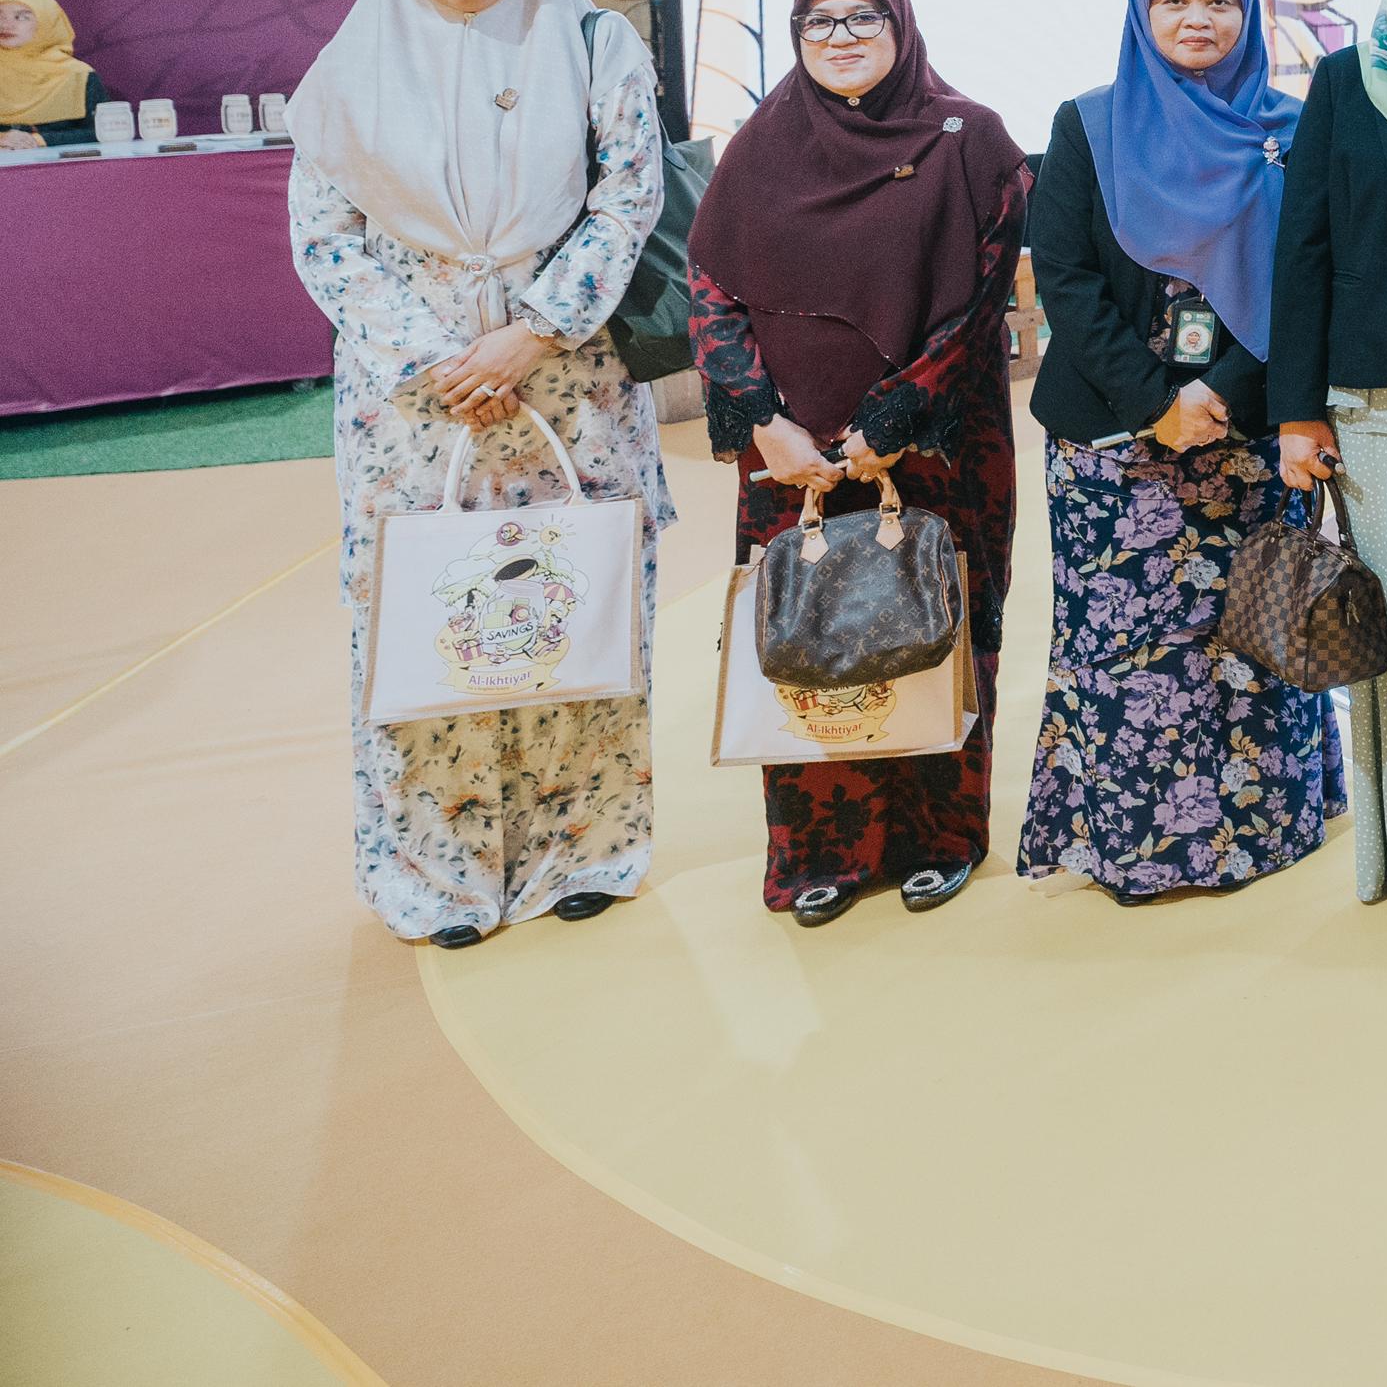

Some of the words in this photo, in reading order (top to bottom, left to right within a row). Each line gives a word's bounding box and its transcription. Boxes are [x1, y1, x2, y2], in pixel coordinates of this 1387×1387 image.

[486, 621, 534, 641] SAVINGS
[468, 671, 533, 687] Al-Ikhtiyar
[806, 723, 862, 736] Al-Ikhtiyar
